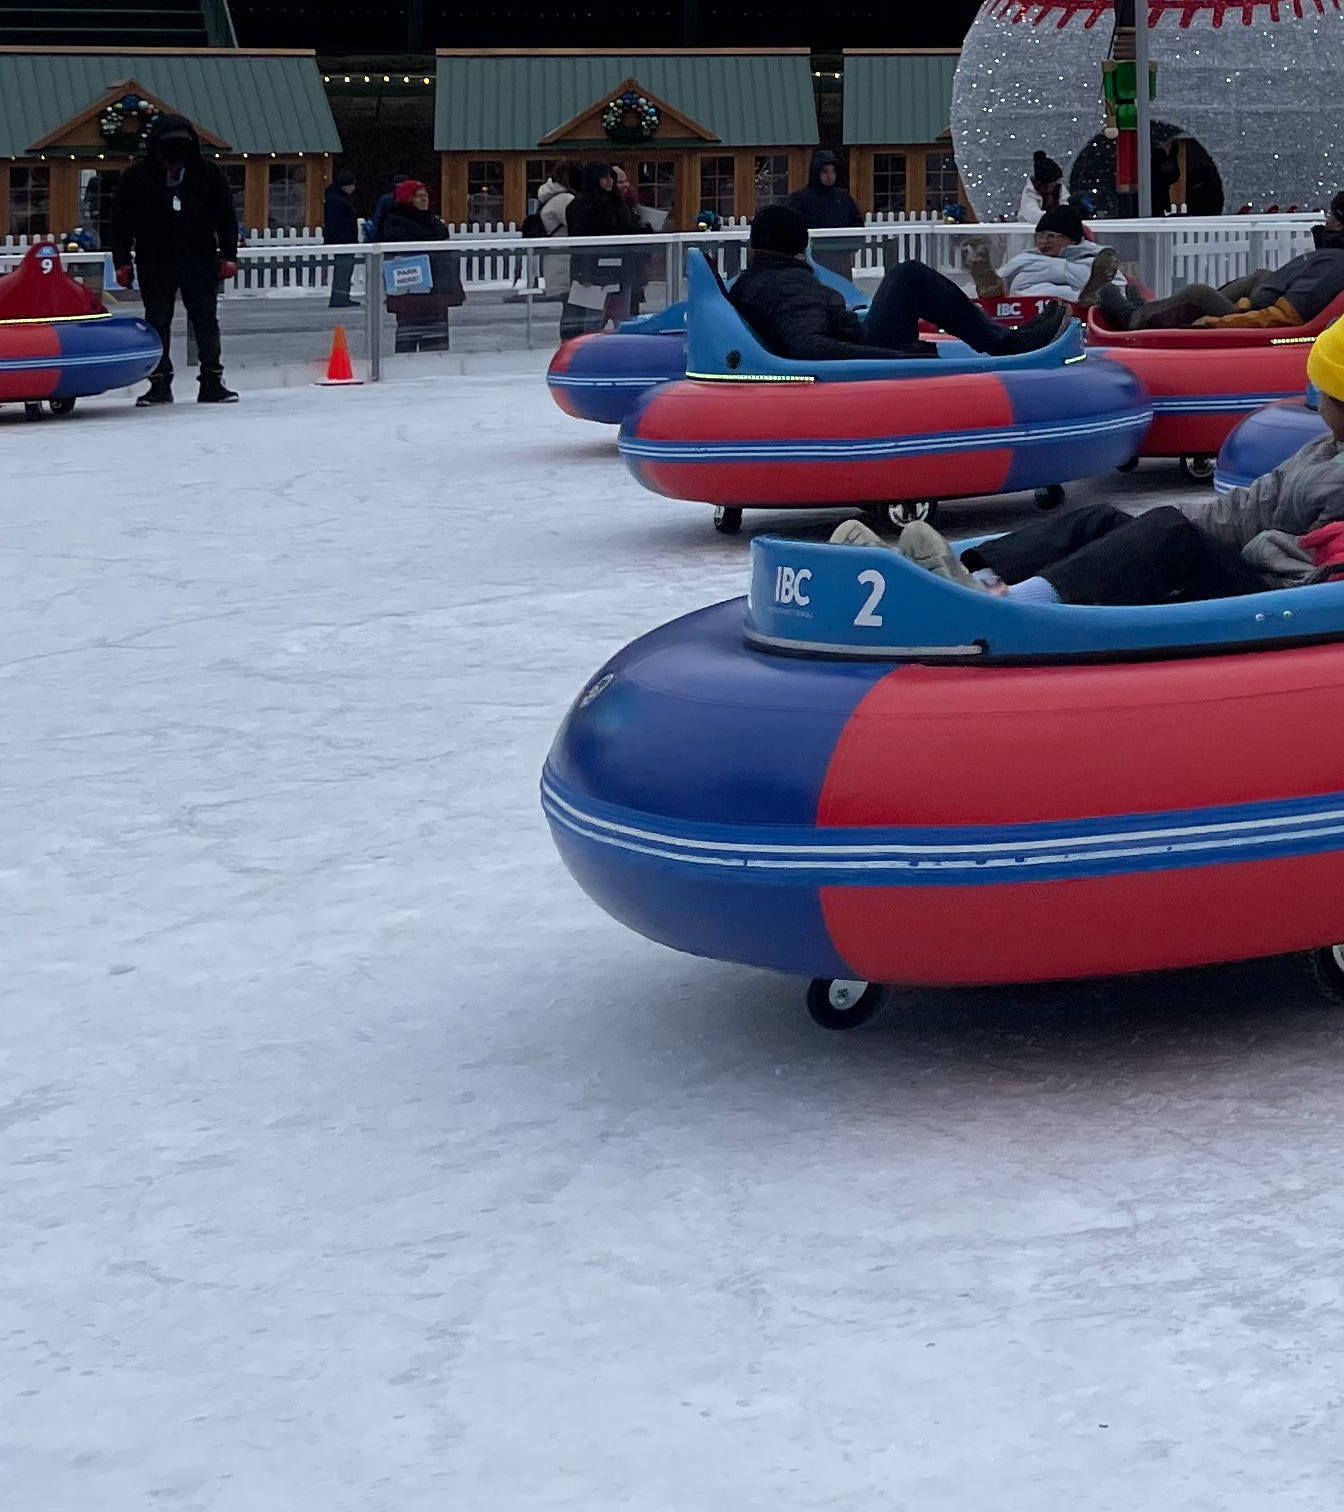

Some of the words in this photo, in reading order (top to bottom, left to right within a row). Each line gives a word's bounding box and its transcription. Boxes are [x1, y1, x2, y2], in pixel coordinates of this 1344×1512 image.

[41, 258, 53, 275] 9
[997, 302, 1022, 317] IBC
[776, 567, 813, 607] IBC
[853, 569, 886, 627] 2
